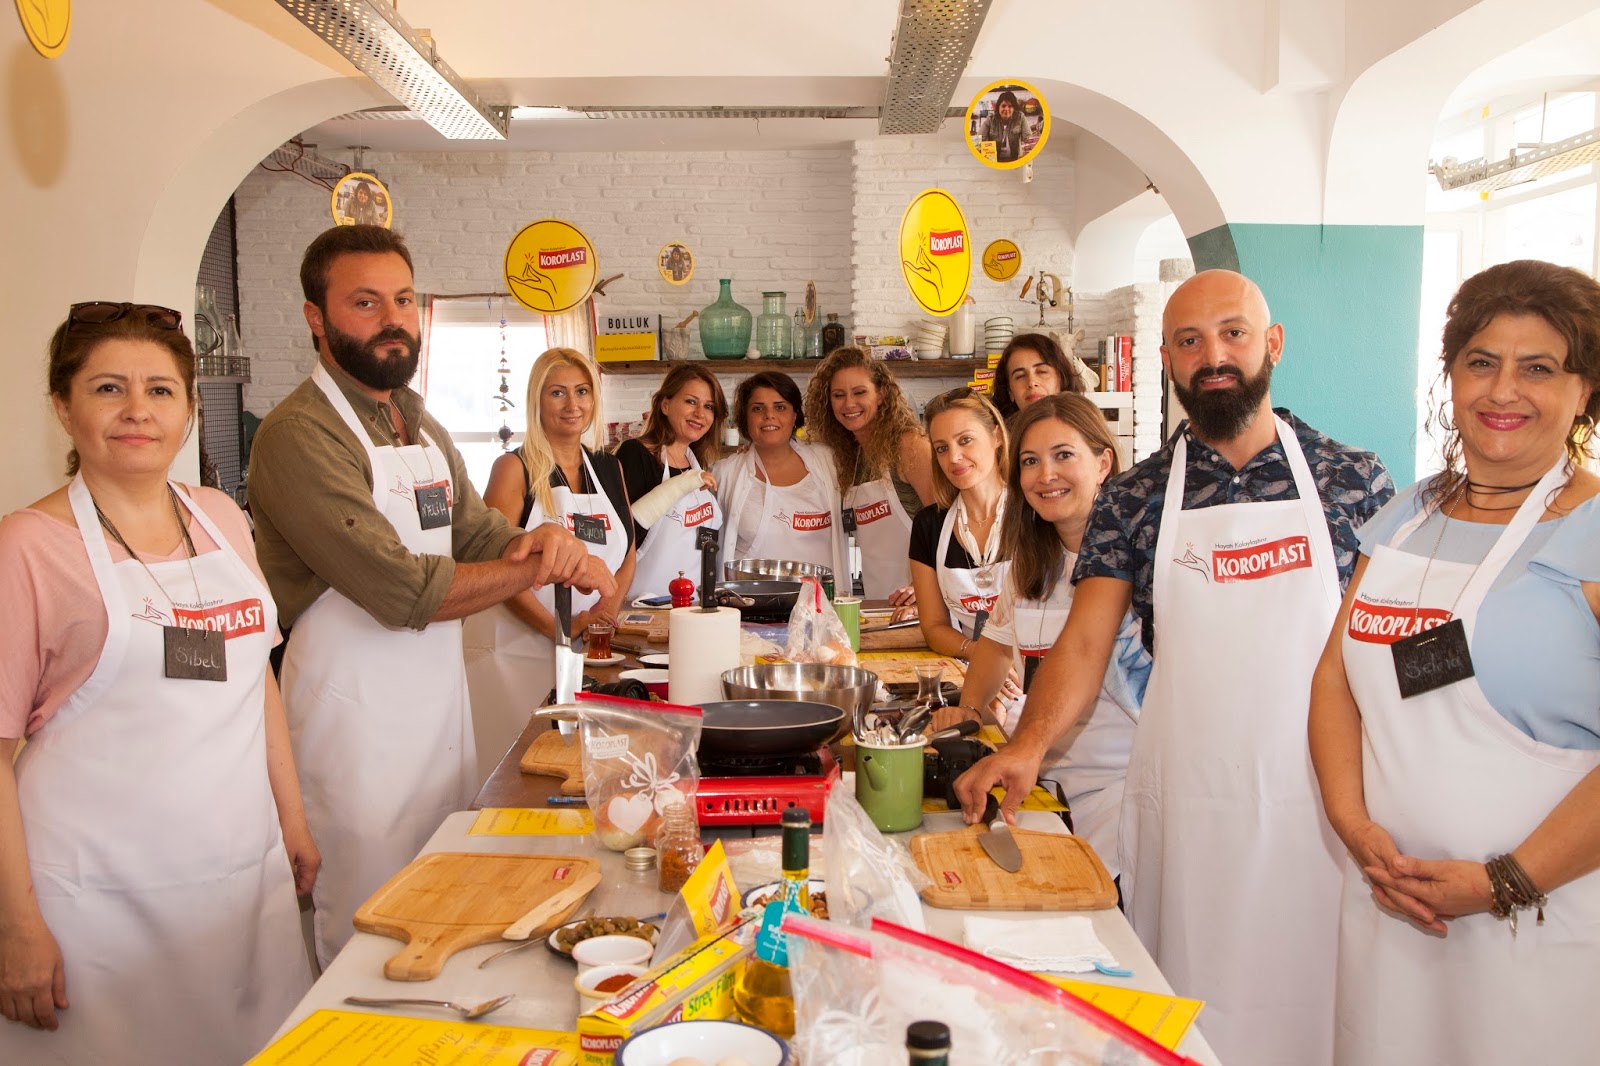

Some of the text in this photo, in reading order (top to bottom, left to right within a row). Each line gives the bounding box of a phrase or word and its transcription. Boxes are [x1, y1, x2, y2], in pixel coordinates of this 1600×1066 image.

[931, 235, 963, 251] KOROPLAST
[540, 251, 585, 266] KOROPLAST
[608, 317, 649, 329] BOLLUK
[686, 506, 712, 524] KOROPLAST
[857, 503, 888, 522] KOROPLAST
[1216, 543, 1306, 577] KOROPLAST
